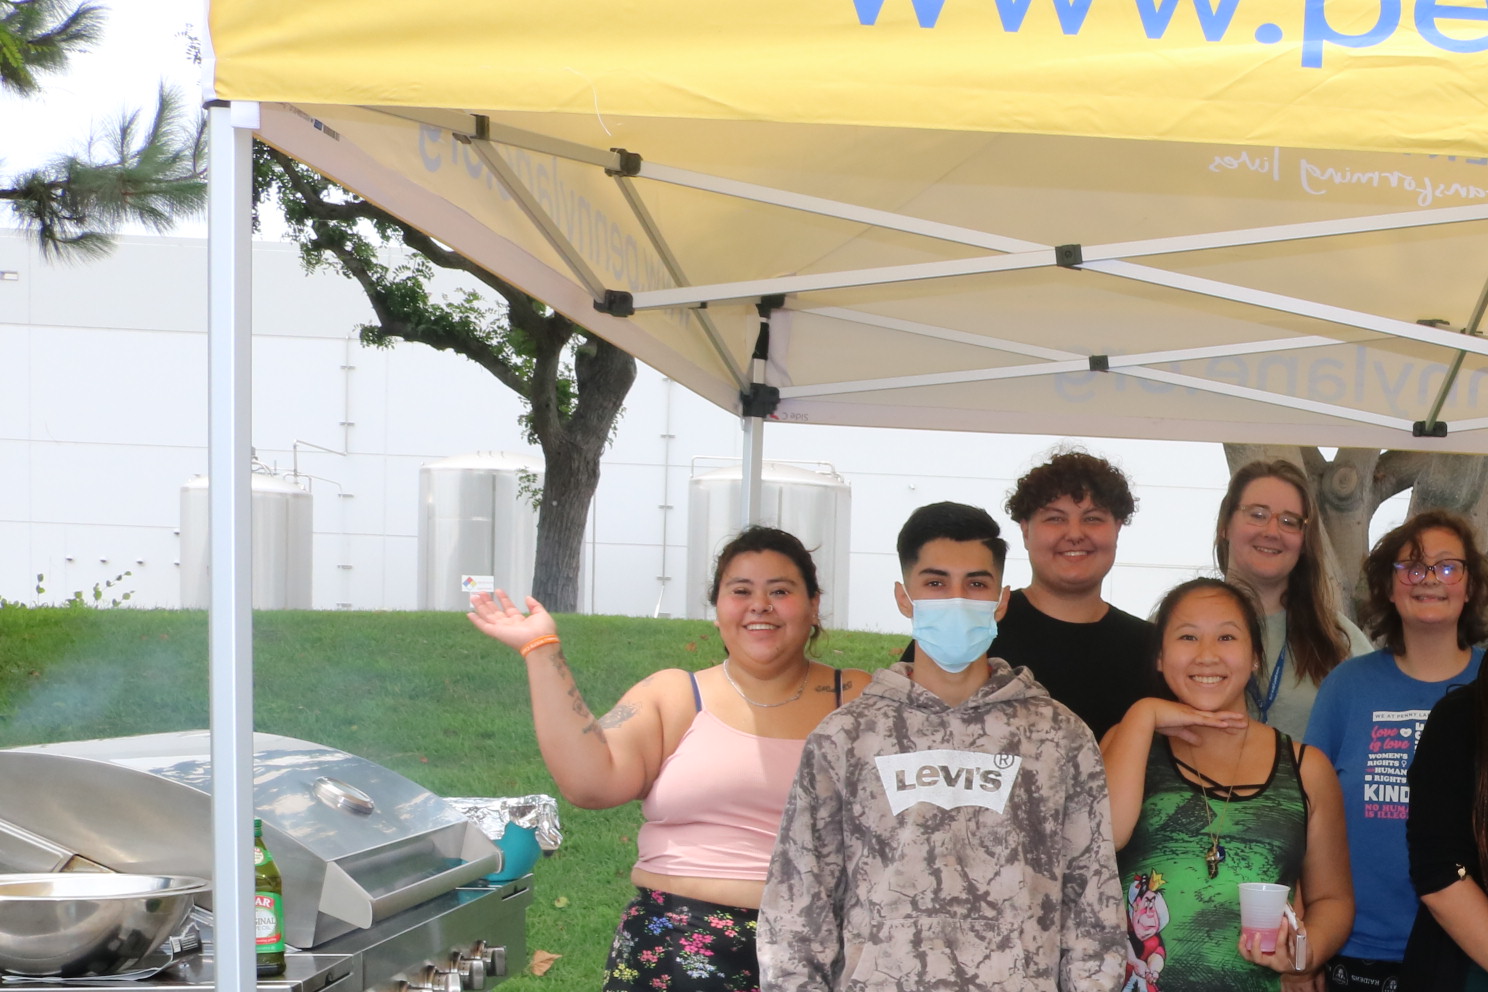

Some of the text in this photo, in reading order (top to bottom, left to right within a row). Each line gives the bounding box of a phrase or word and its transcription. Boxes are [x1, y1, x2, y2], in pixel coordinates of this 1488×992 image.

[782, 412, 809, 422] Side C
[1369, 738, 1382, 752] is
[1374, 767, 1408, 776] HUMAN
[1374, 775, 1407, 783] RIGHTS
[1364, 784, 1410, 803] KIND
[1365, 804, 1409, 813] NO HUM
[1377, 811, 1409, 819] ILLEG
